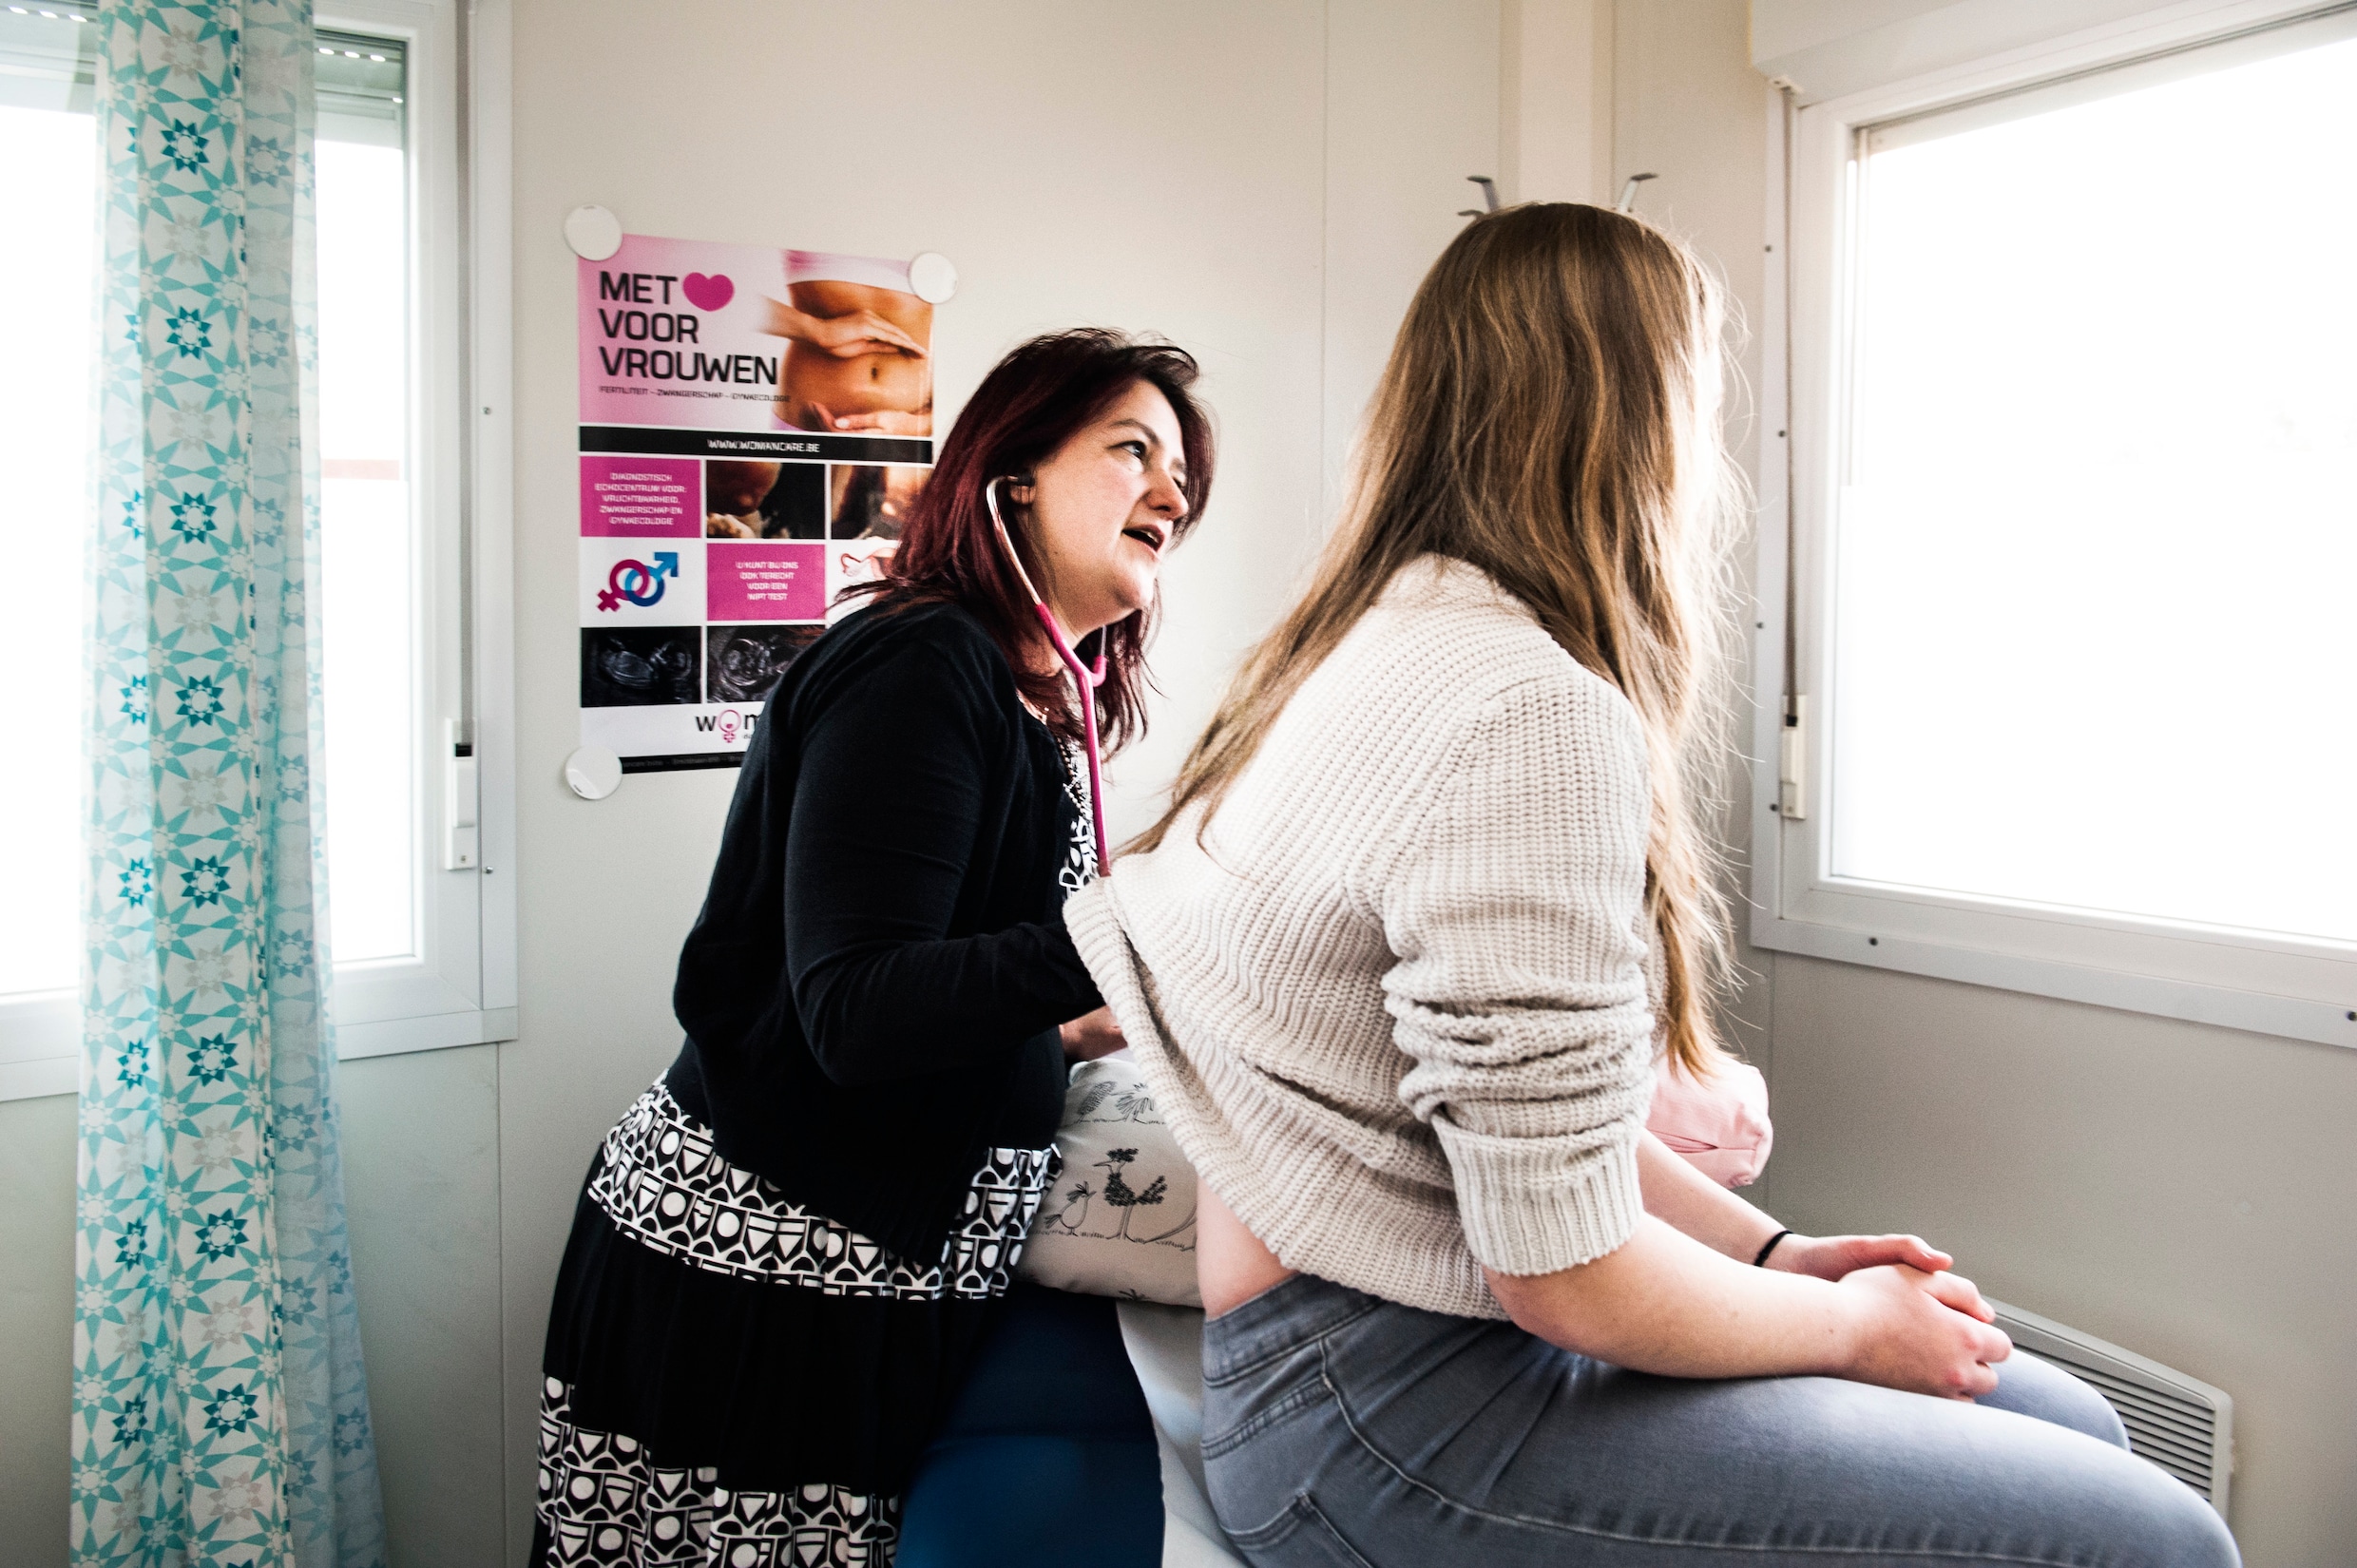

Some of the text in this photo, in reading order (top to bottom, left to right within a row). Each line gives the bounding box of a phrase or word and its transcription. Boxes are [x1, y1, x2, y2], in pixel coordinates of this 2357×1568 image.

[600, 271, 678, 305] MET
[599, 308, 699, 344] VOOR
[599, 346, 777, 385] VROUWEN
[599, 386, 648, 395] FERTILITEIT
[657, 388, 724, 399] ZWANGERSCHAP
[731, 392, 791, 402] GYNAECOLOGIE
[707, 439, 820, 452] WWW.WOMANCARE.BE
[610, 472, 672, 482] DIAGNOSTISCH
[594, 483, 660, 492] ECHOCENTRUM
[600, 505, 669, 514] ZWANGERSCHAP
[609, 516, 674, 525] GYNAECOLOGIE
[744, 561, 767, 569] KUNT
[739, 571, 795, 580] OOK TERECHT
[746, 582, 770, 590] VOOR
[767, 592, 788, 601] TEST
